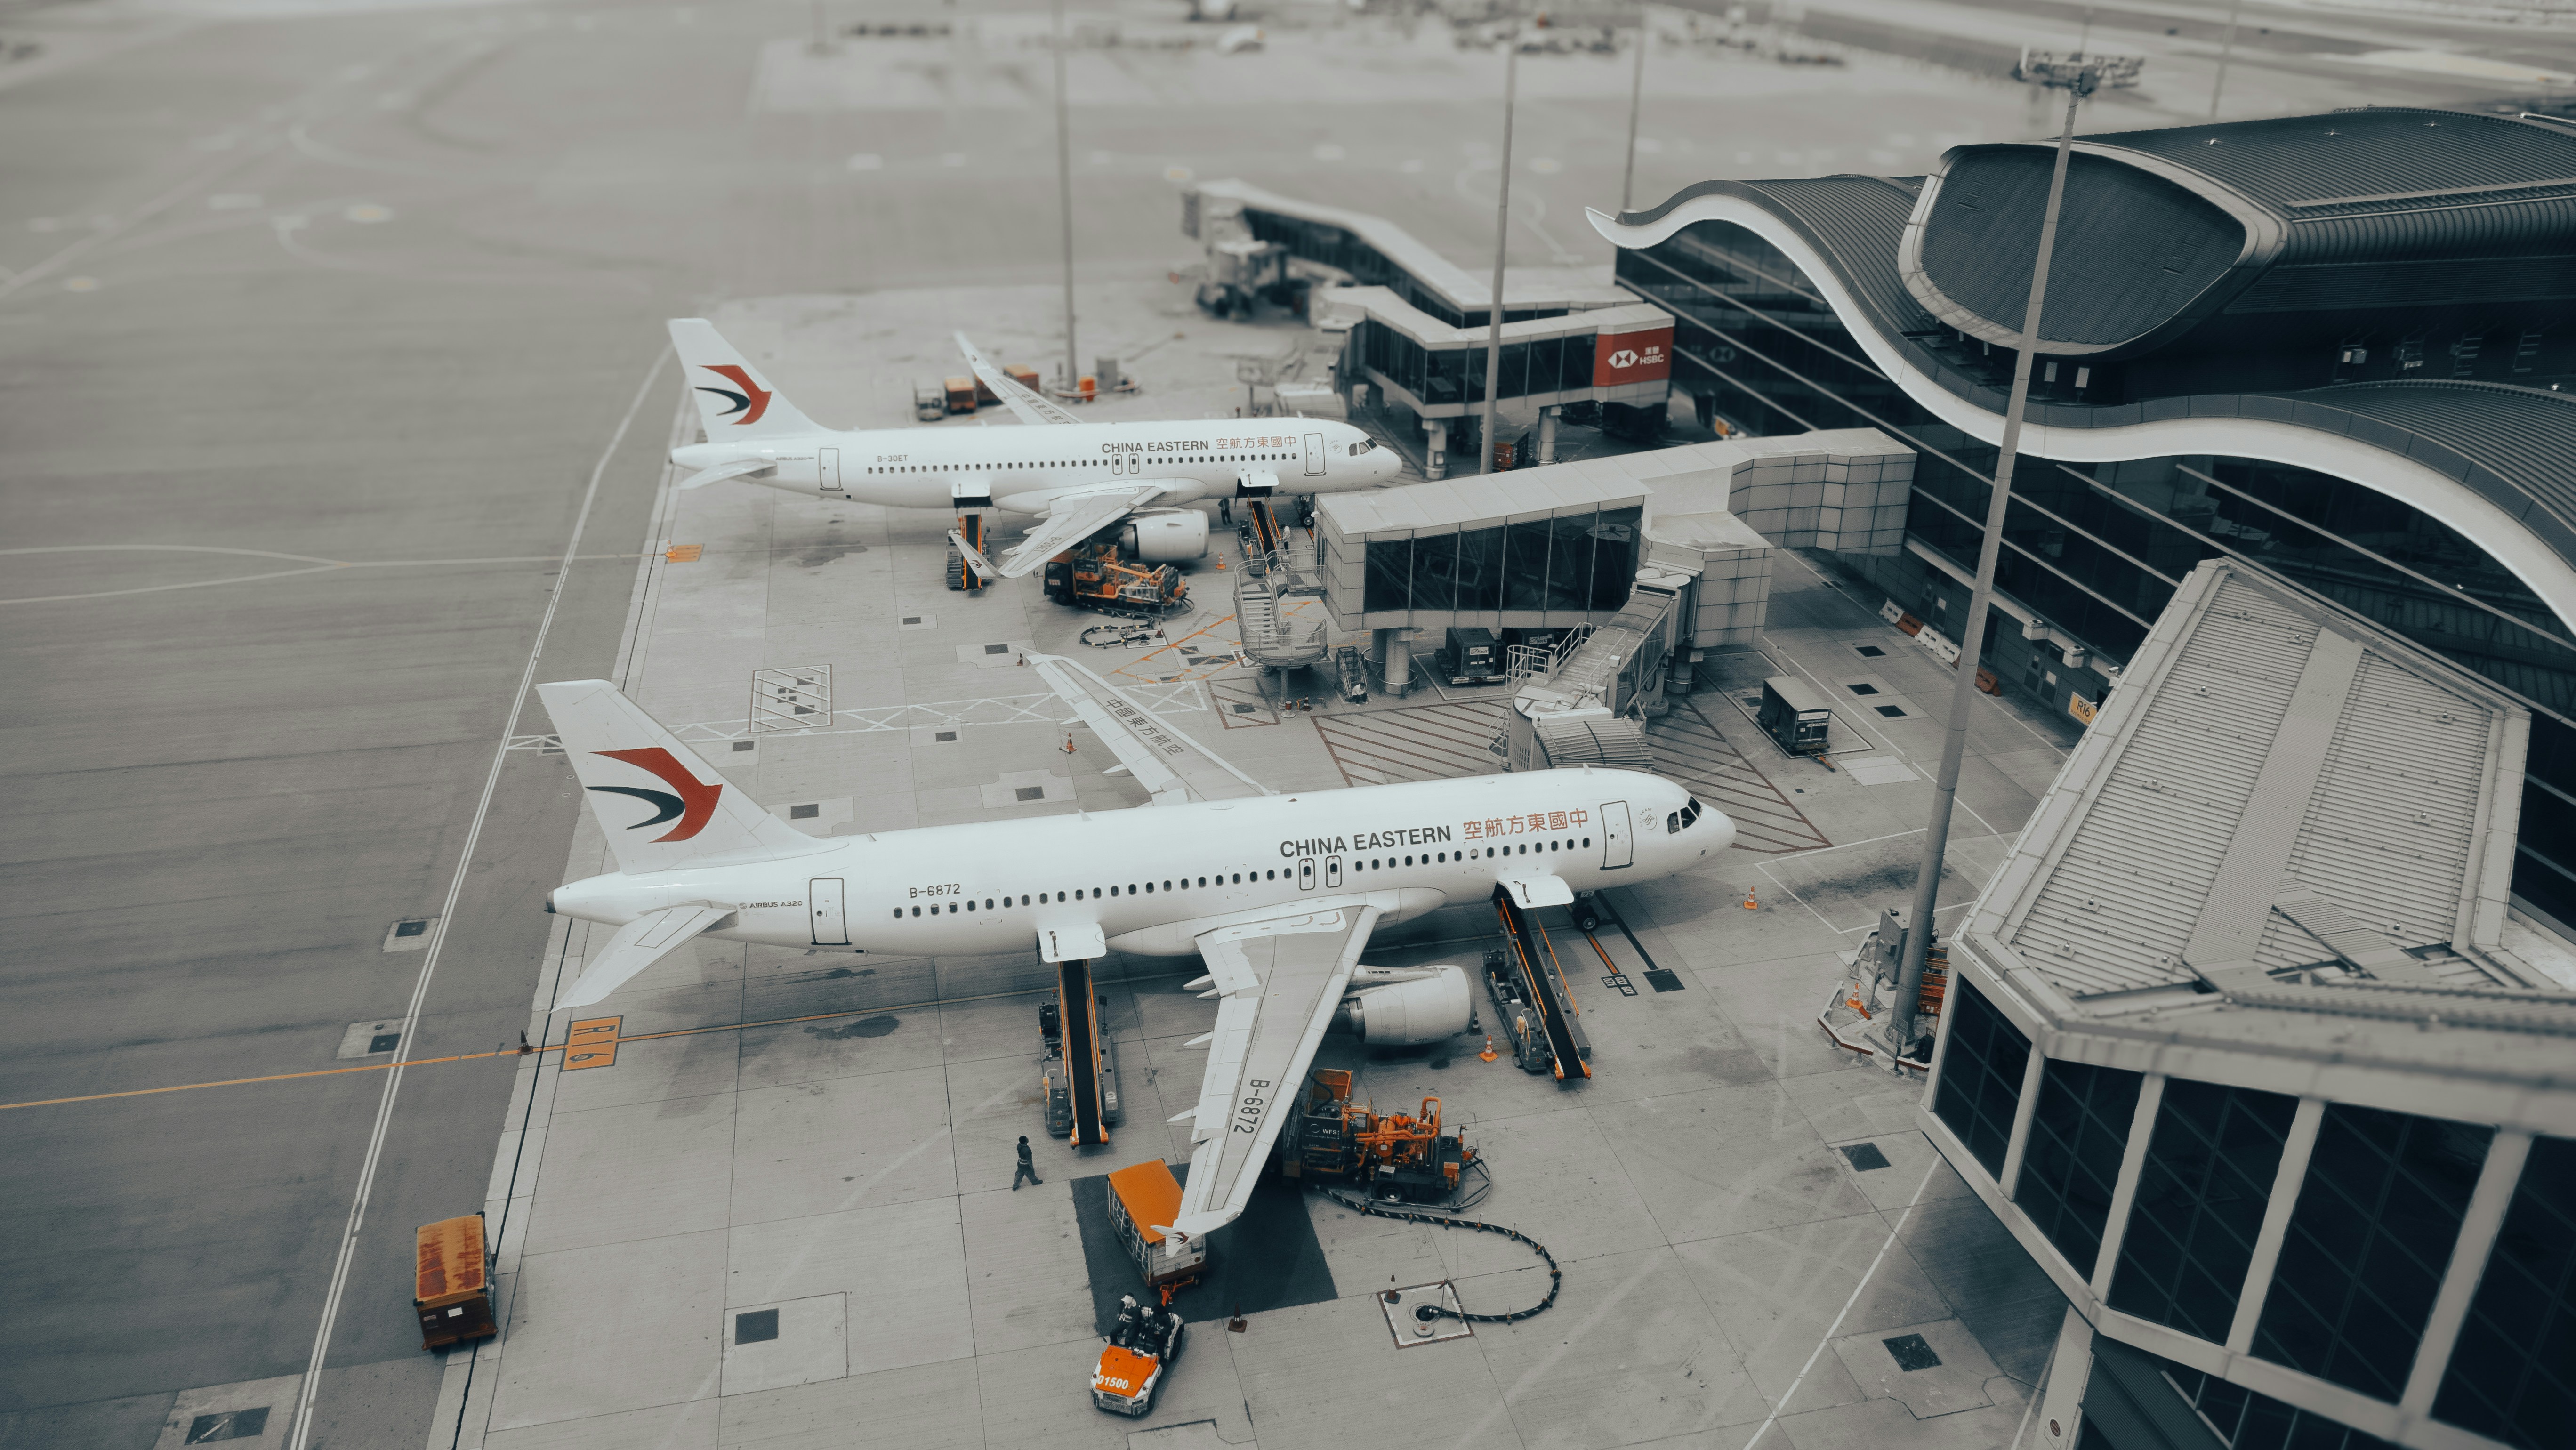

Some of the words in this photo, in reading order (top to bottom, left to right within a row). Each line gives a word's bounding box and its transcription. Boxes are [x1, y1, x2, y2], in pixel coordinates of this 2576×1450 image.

[1639, 354, 1664, 365] HSBC
[1102, 443, 1143, 454] CHINA
[1148, 440, 1208, 452] EASTERN
[2077, 700, 2090, 717] R16
[1106, 699, 1184, 755] 中國東方航空
[1280, 836, 1347, 857] CHINA
[1353, 825, 1451, 851] EASTERN
[910, 883, 961, 898] B-6872
[569, 1025, 616, 1063] R16
[1233, 1079, 1270, 1133] B-6872
[1097, 1375, 1129, 1390] 01500
